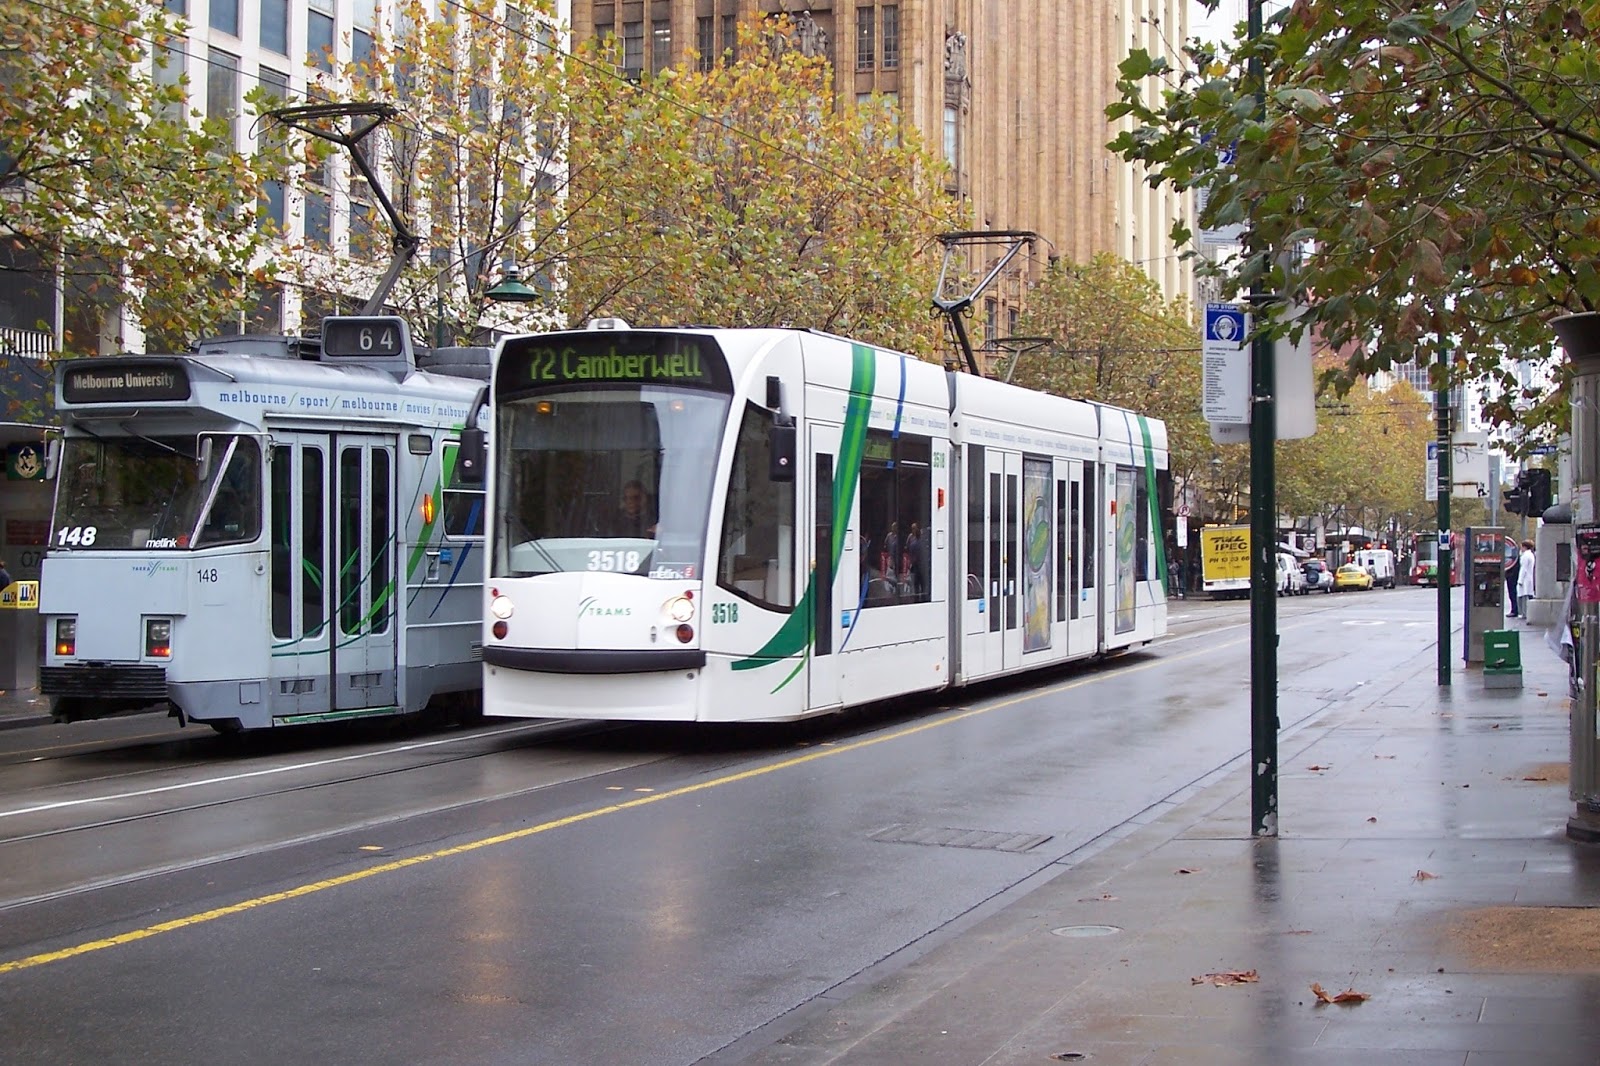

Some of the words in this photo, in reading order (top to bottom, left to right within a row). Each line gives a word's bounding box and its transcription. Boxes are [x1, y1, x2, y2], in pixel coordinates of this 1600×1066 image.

[360, 327, 394, 351] 64
[528, 347, 557, 380] 72
[561, 344, 702, 379] Camberwell
[73, 374, 124, 389] Melbourne
[125, 372, 175, 389] University
[219, 390, 286, 405] melbourne
[300, 396, 329, 408] sport
[342, 397, 398, 412] melbourne
[406, 403, 431, 416] movies
[438, 405, 470, 418] melbourn
[58, 526, 97, 546] 148
[146, 538, 177, 548] metlink
[1215, 542, 1248, 551] IPEC
[587, 550, 640, 571] 3518
[197, 569, 218, 583] 148
[589, 607, 632, 616] TRAMS
[712, 603, 739, 624] 3518
